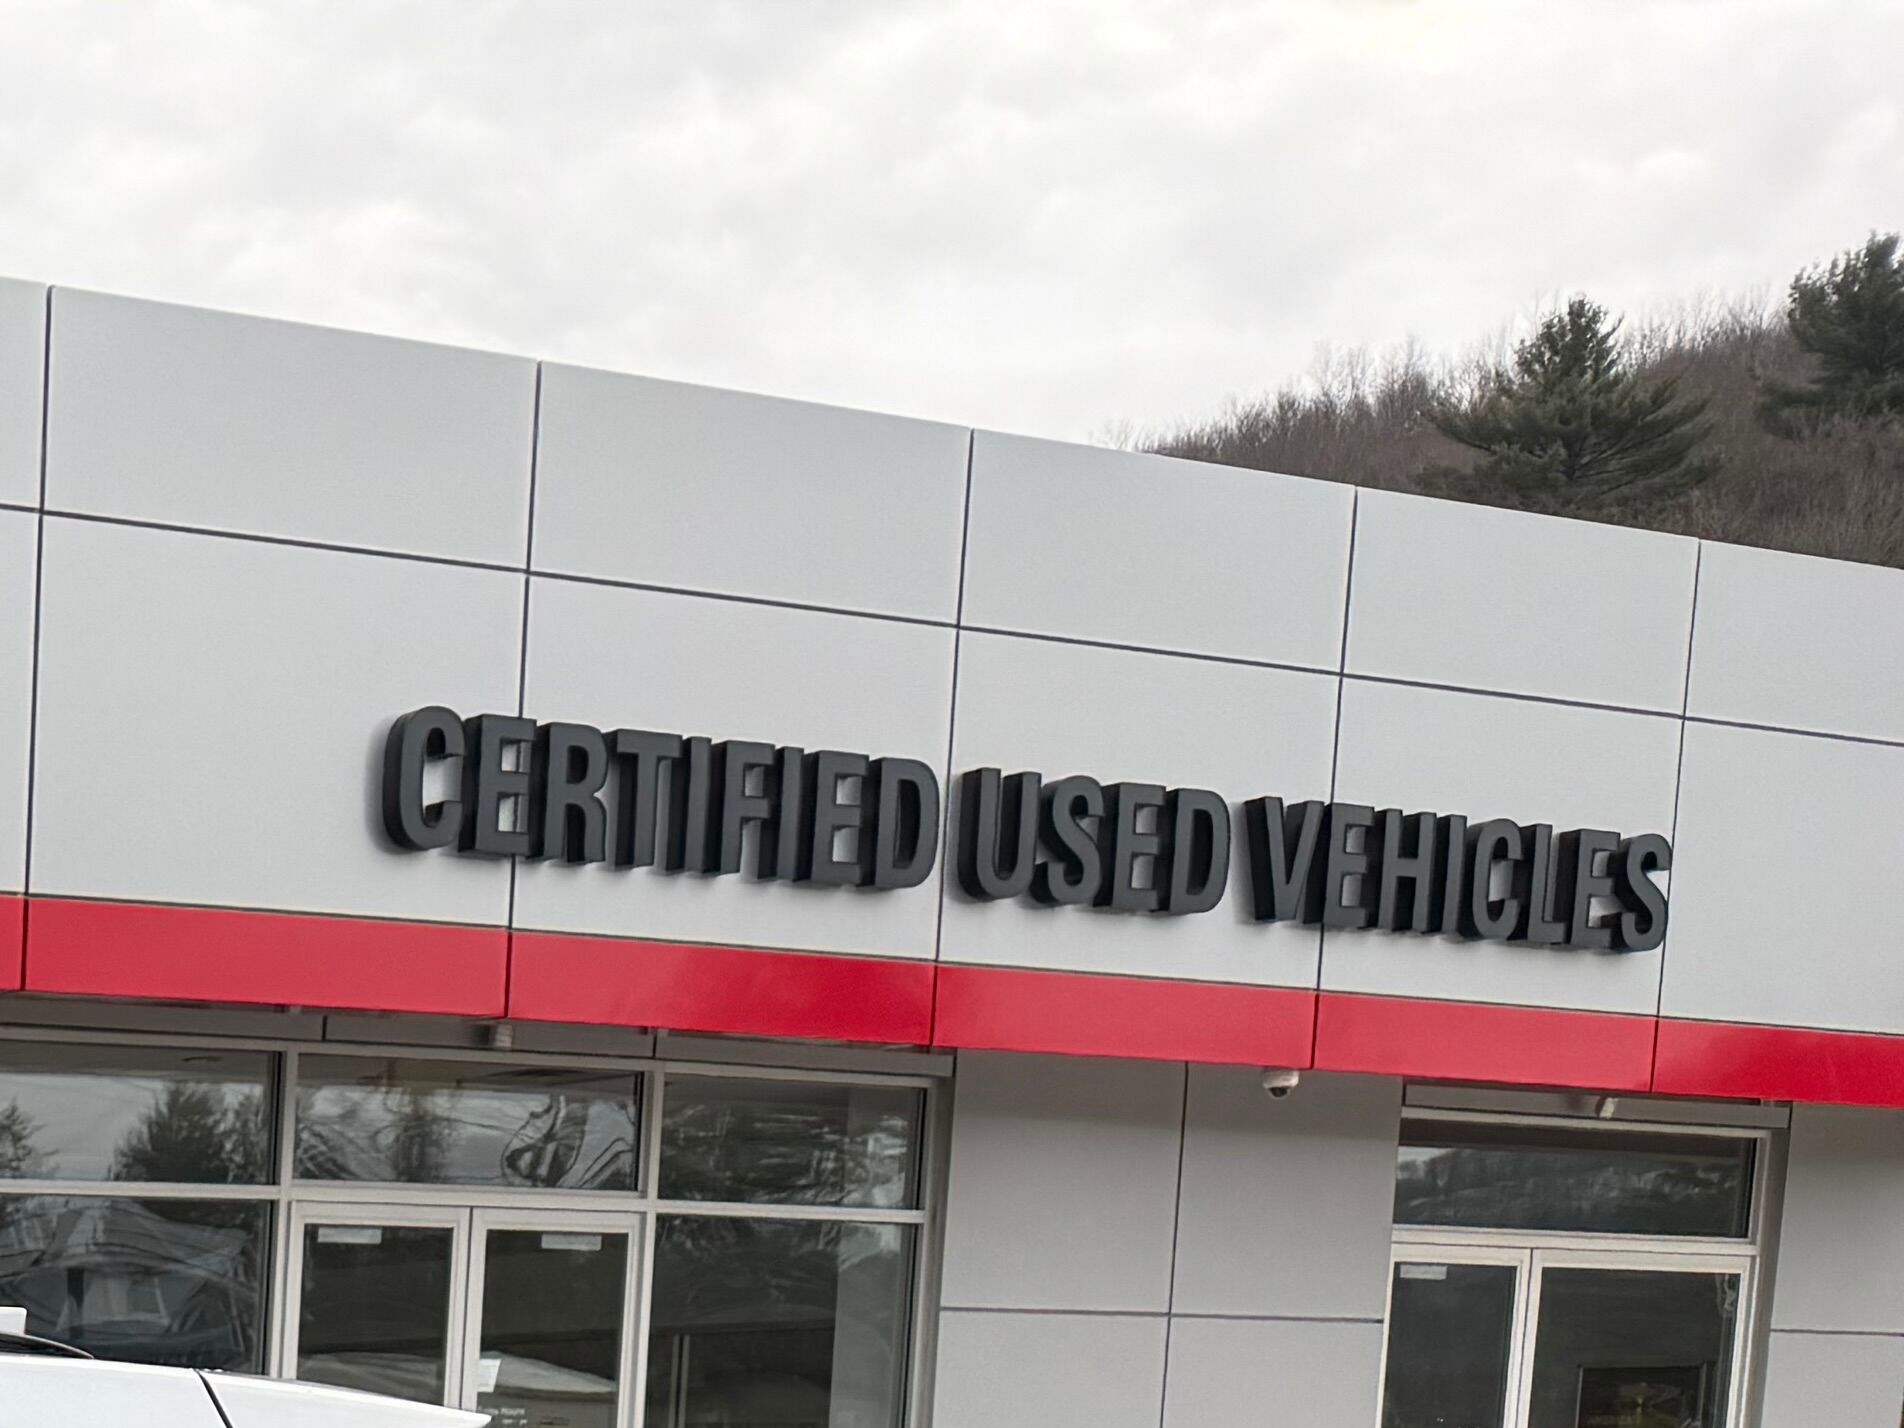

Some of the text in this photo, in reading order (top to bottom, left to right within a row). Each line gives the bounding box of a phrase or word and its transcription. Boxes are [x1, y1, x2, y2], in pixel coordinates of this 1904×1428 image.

[386, 704, 1673, 955] CERTIFIED USED VEHICLES
